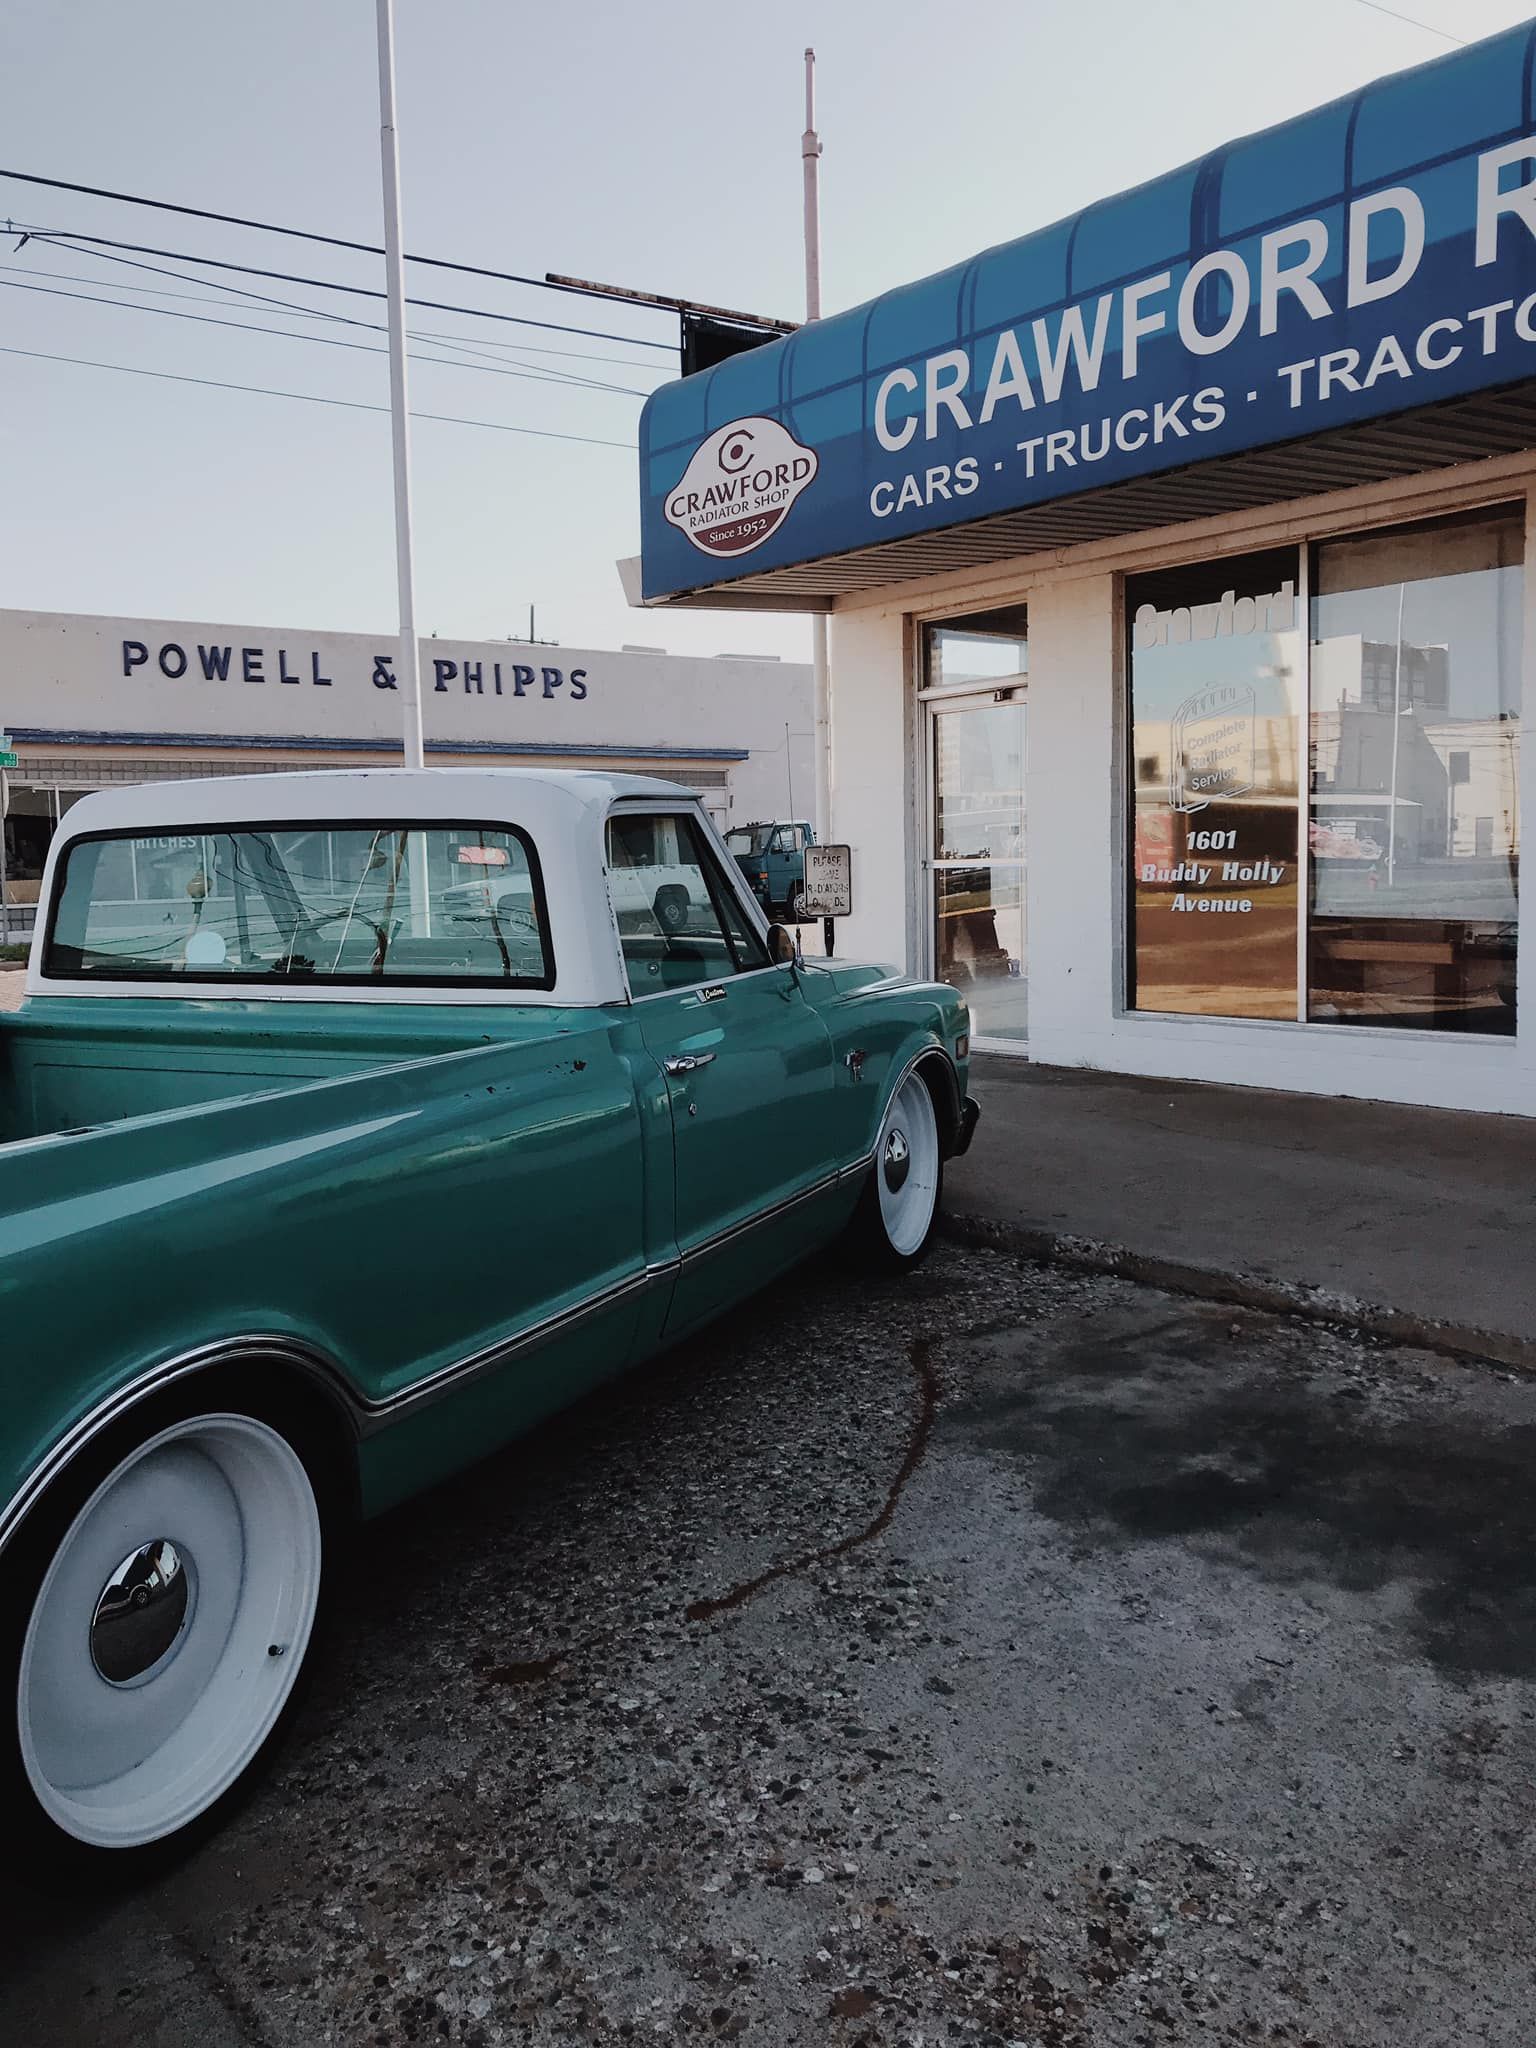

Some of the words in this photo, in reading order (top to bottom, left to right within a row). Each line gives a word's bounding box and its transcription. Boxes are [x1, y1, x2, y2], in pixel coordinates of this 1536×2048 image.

[874, 186, 1425, 452] CRAWFORD
[870, 457, 979, 518] CARS
[1017, 386, 1226, 478] TRUCKS
[670, 457, 811, 518] CRAWFORD
[689, 501, 749, 528] RADIATOR
[754, 488, 790, 509] SHOP
[709, 530, 735, 543] Since
[736, 518, 768, 537] 1952
[1135, 580, 1294, 648] Crawford
[123, 640, 332, 686] POWELL
[372, 656, 398, 690] &
[433, 659, 588, 700] PHIPPS
[1187, 720, 1246, 749] Complete
[1191, 767, 1238, 790] Service
[1186, 830, 1237, 850] 1601
[813, 855, 842, 867] PLEASE
[1141, 863, 1212, 884] Buddy
[1222, 861, 1285, 884] Holly
[808, 883, 849, 894] RDATORS
[1171, 893, 1253, 912] Avenue
